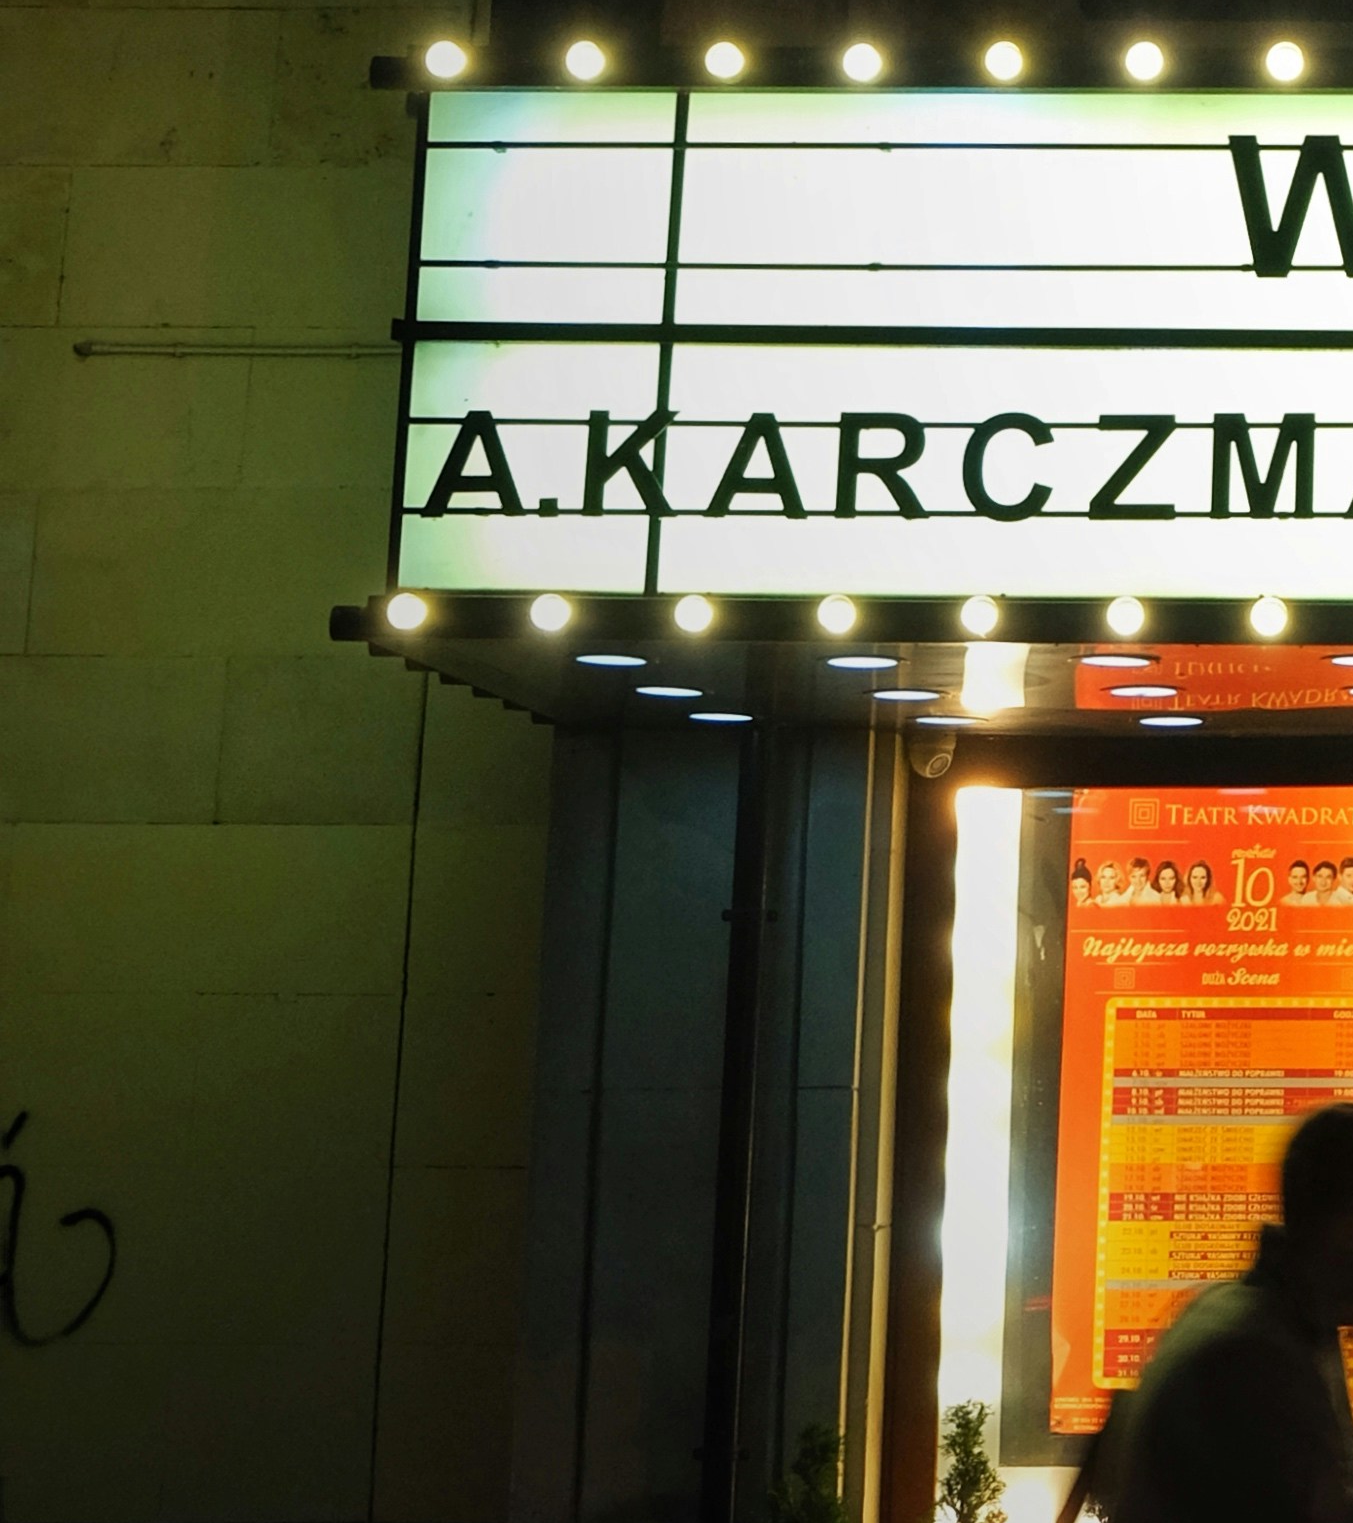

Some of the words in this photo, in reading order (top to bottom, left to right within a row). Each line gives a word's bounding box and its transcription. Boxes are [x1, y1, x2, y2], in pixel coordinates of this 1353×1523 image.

[1226, 907, 1278, 932] 2021
[1082, 935, 1189, 964] Najlepsza
[1193, 938, 1289, 963] rozrywka
[1293, 940, 1311, 956] w
[1226, 967, 1281, 986] Scena
